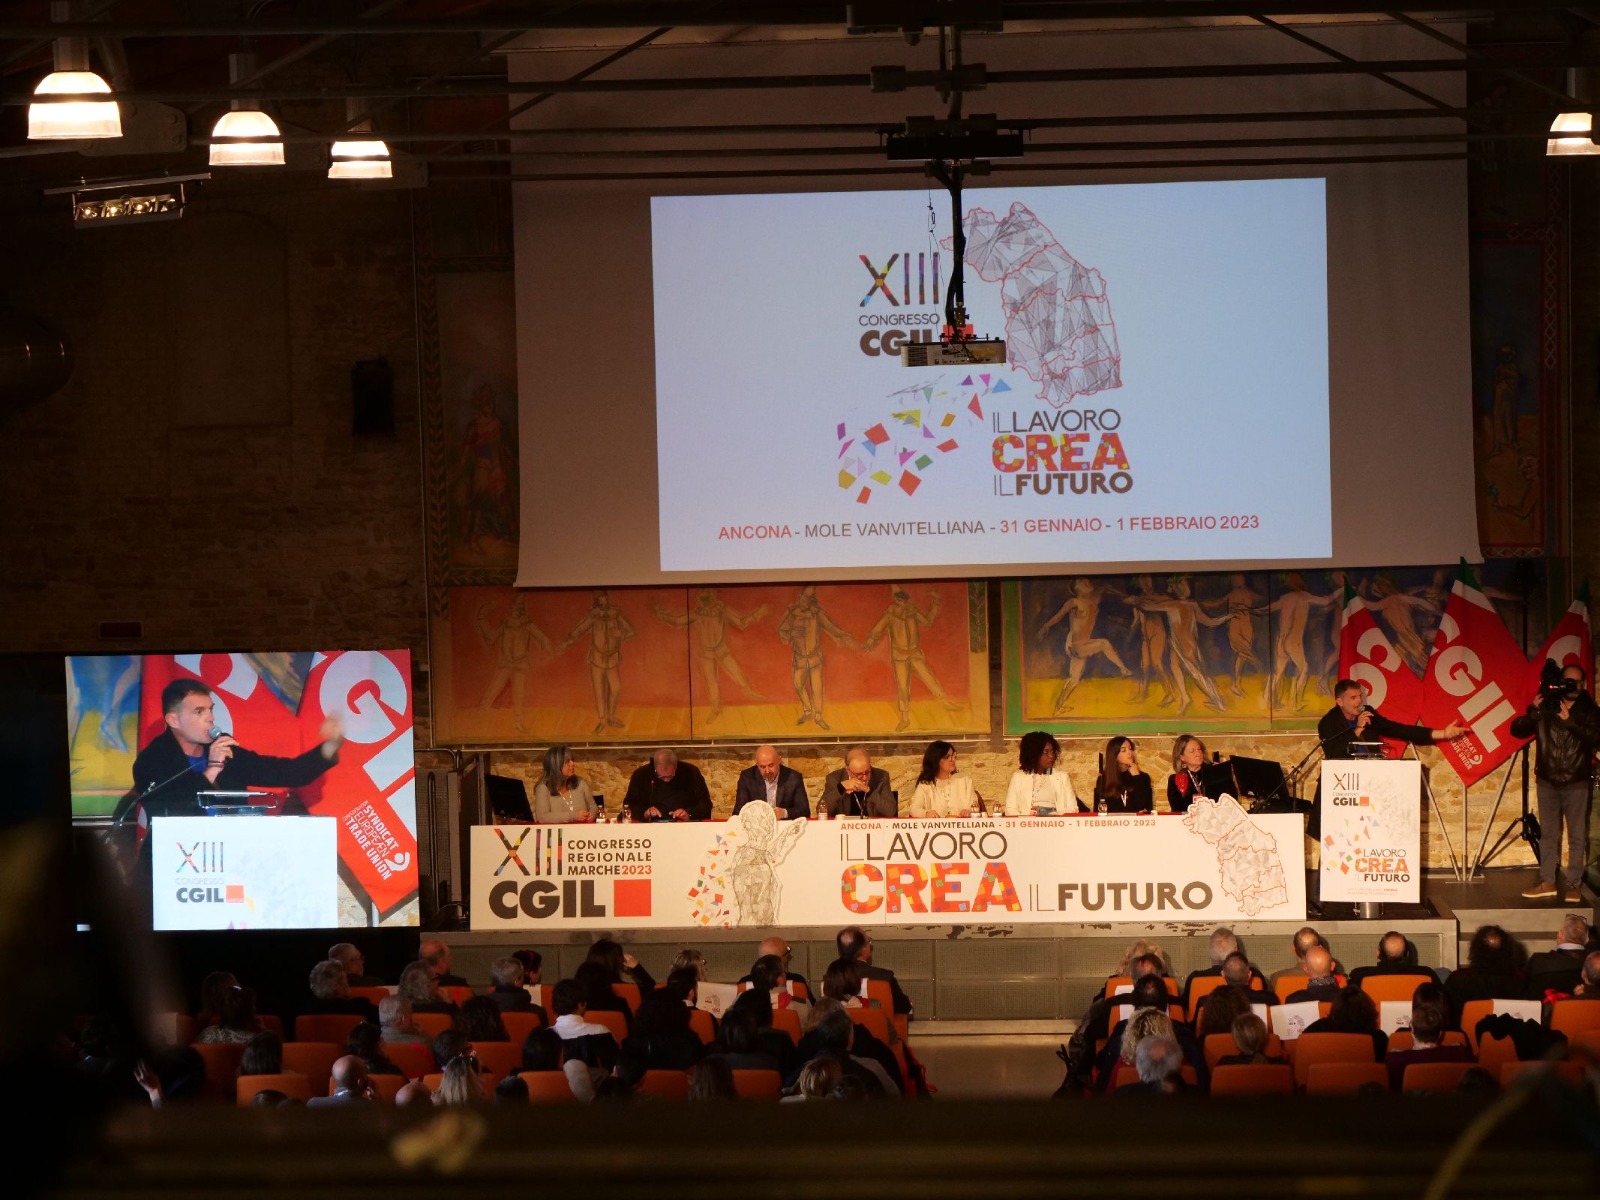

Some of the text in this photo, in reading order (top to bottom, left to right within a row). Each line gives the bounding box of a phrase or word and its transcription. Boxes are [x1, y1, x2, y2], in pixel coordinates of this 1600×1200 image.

[859, 252, 939, 307] XIII
[859, 313, 940, 327] CONGRESSO
[992, 432, 1130, 473] CREA
[1016, 471, 1133, 496] FUTURO
[718, 525, 792, 540] ANCONA
[805, 523, 852, 538] MOLE
[856, 520, 986, 537] VANVITELLIANA
[1000, 520, 1018, 533] 31
[1024, 518, 1102, 533] GENNAIO
[1117, 518, 1124, 531] 1
[1130, 515, 1216, 531] FEBBRAIO
[1219, 515, 1260, 529] 2023
[1333, 773, 1359, 790] XIII
[1333, 797, 1359, 806] CGIL
[363, 804, 399, 850] SYNDICAT
[840, 822, 882, 830] ANCONA
[892, 822, 918, 830] MOLE
[921, 821, 995, 829] VANVITELLIANA
[1005, 820, 1016, 828] 31
[1020, 820, 1065, 828] GENNAIO
[1085, 819, 1130, 827] FEBBRAIO
[1133, 819, 1156, 827] 2023
[345, 817, 372, 850] TRADE
[366, 847, 392, 880] UNION
[493, 827, 563, 876] XIII
[568, 839, 652, 849] CONGRESSO
[1363, 848, 1406, 857] LAVORO
[176, 841, 224, 873] XIII
[568, 852, 652, 863] REGIONALE
[1355, 858, 1409, 873] CREA
[841, 862, 1022, 914] CREA
[1058, 881, 1213, 911] FUTURO
[1364, 873, 1410, 882] FUTURO
[176, 887, 224, 903] CGIL
[489, 879, 606, 919] CGIL
